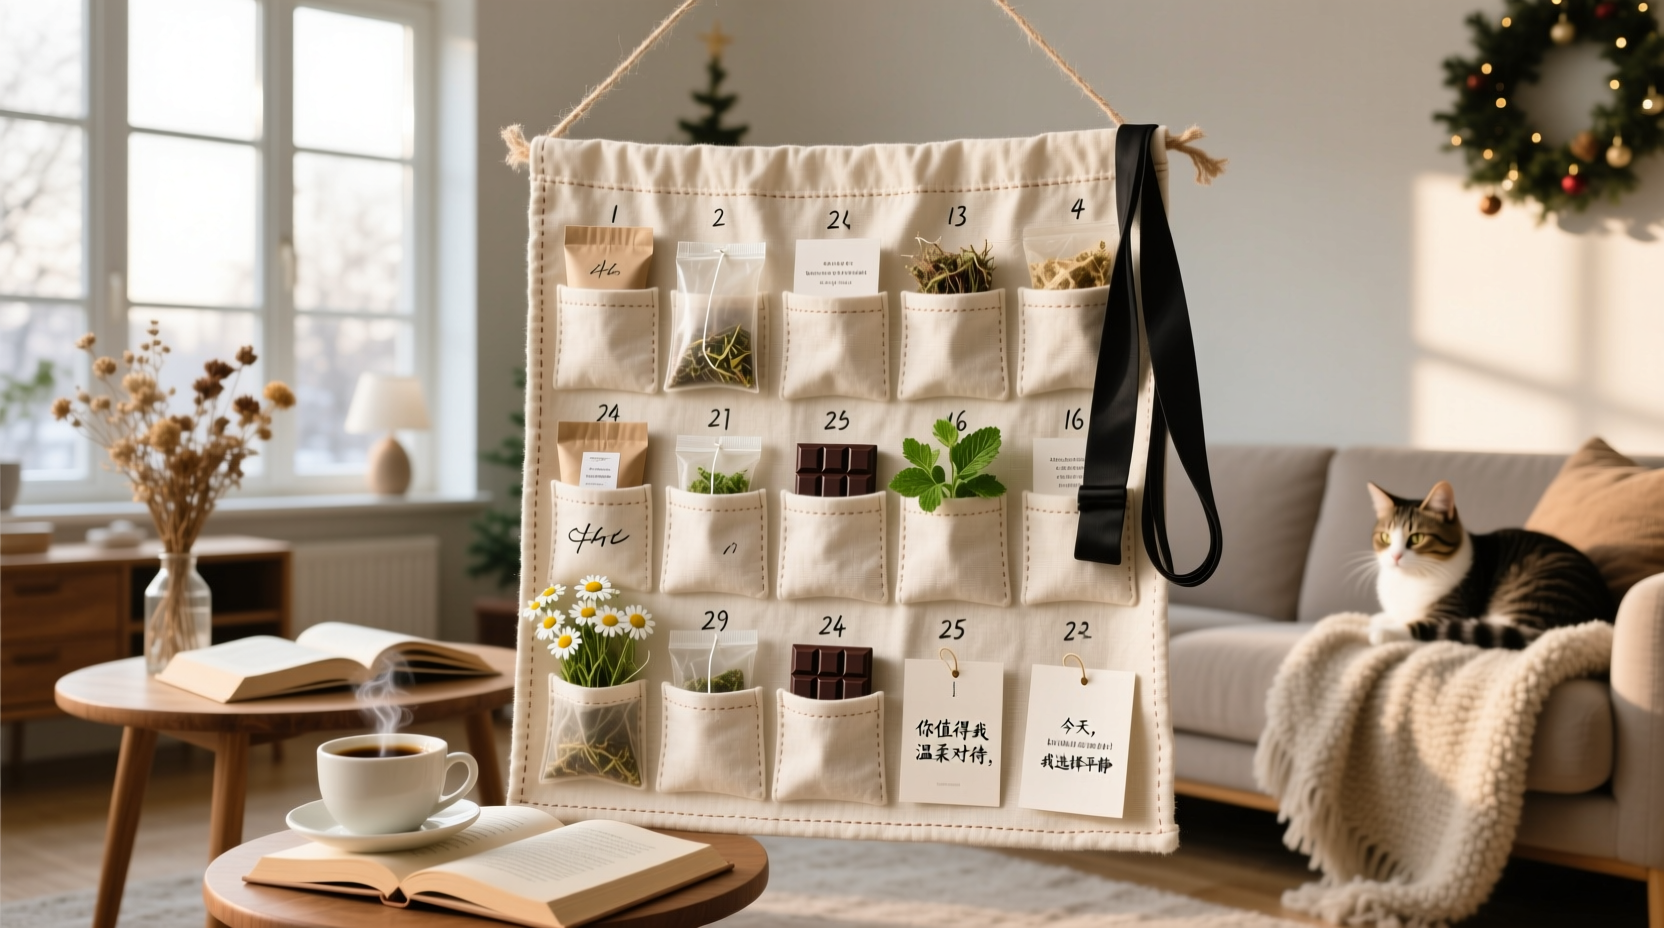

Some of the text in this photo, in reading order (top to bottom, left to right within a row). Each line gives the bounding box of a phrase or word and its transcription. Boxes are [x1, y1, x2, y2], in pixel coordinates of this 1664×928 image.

[611, 204, 618, 224] 1
[712, 208, 726, 228] 2
[947, 205, 968, 227] 13
[1070, 199, 1087, 220] 4
[596, 403, 621, 424] 24
[707, 407, 731, 431] 21
[823, 409, 850, 431] 25
[1064, 407, 1084, 431] 16
[701, 609, 730, 633] 29
[818, 614, 847, 638] 24
[938, 618, 967, 641] 25
[915, 718, 990, 741] 你值得我
